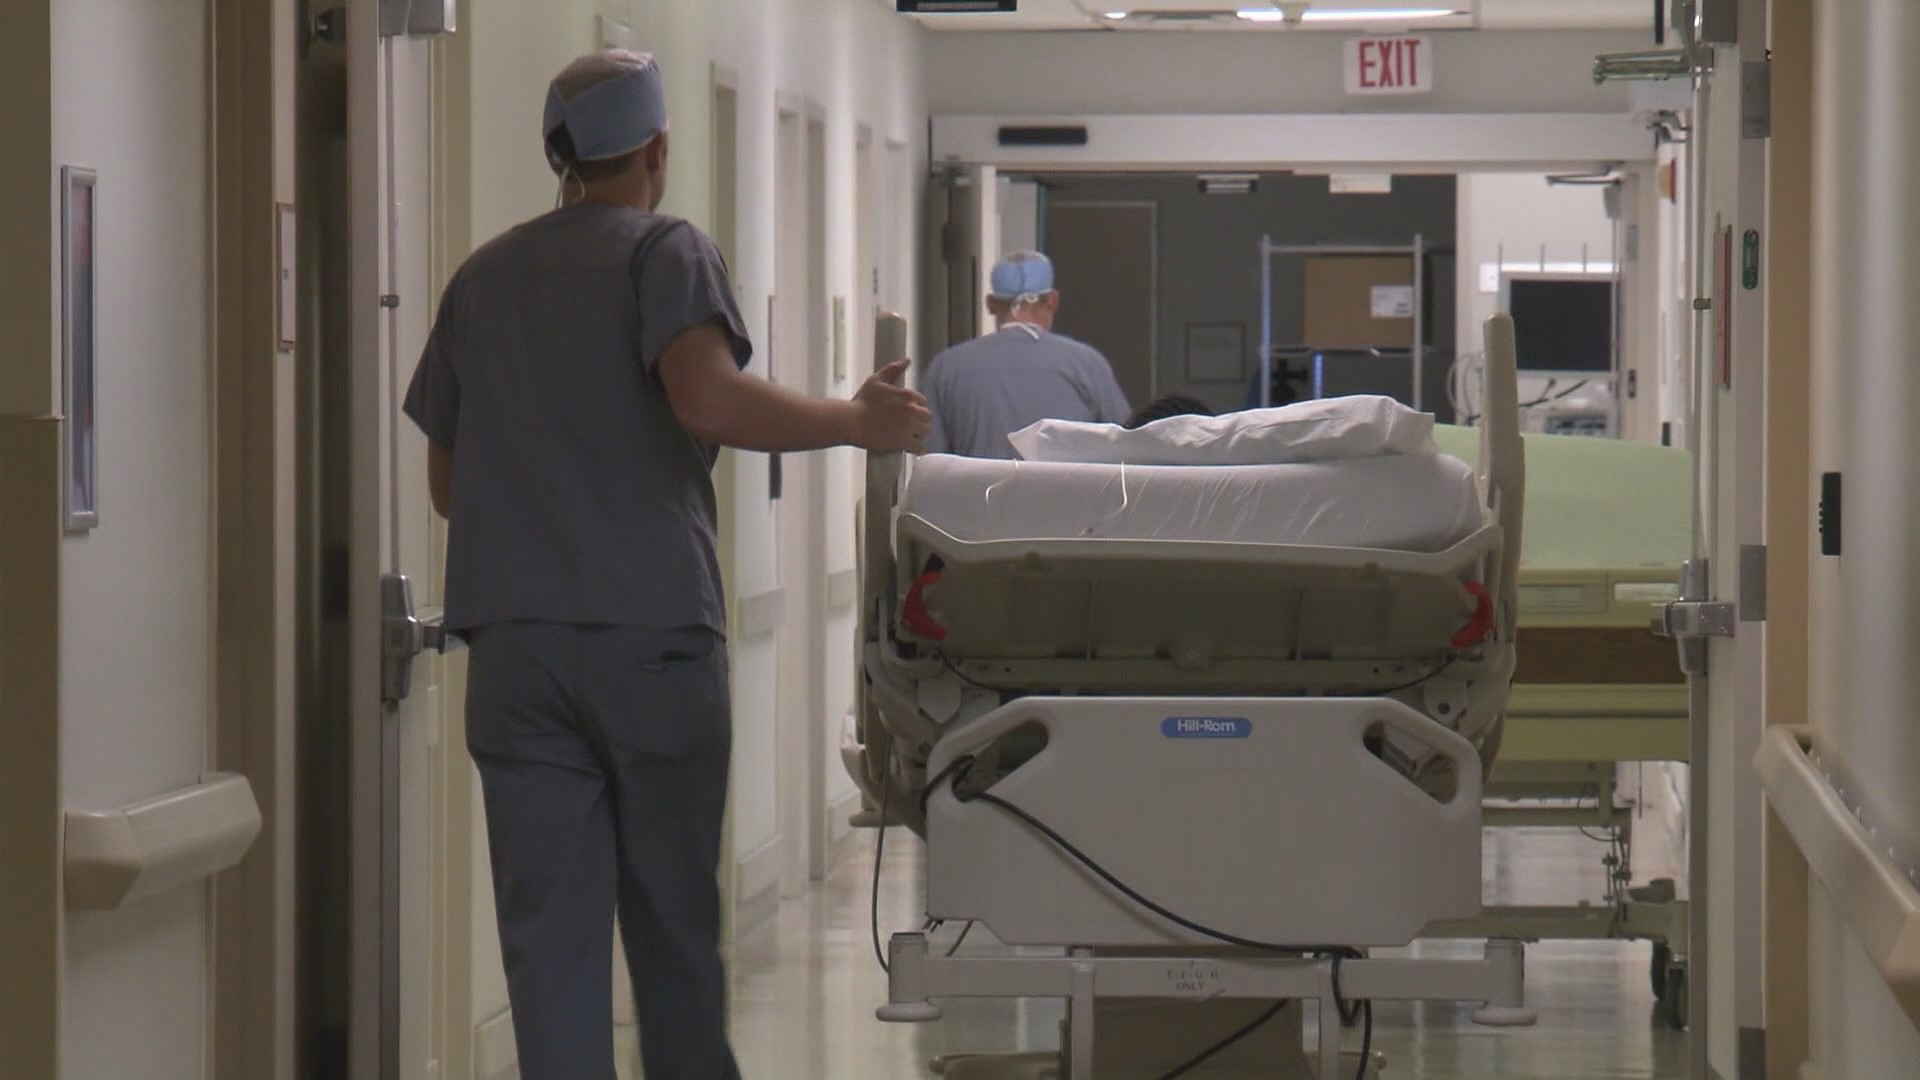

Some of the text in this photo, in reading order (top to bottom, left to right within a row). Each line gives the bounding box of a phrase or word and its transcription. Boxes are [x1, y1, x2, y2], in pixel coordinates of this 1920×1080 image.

[1359, 39, 1420, 87] EXIT
[1177, 719, 1236, 732] Hill-Rom
[1176, 981, 1204, 991] ONLY
